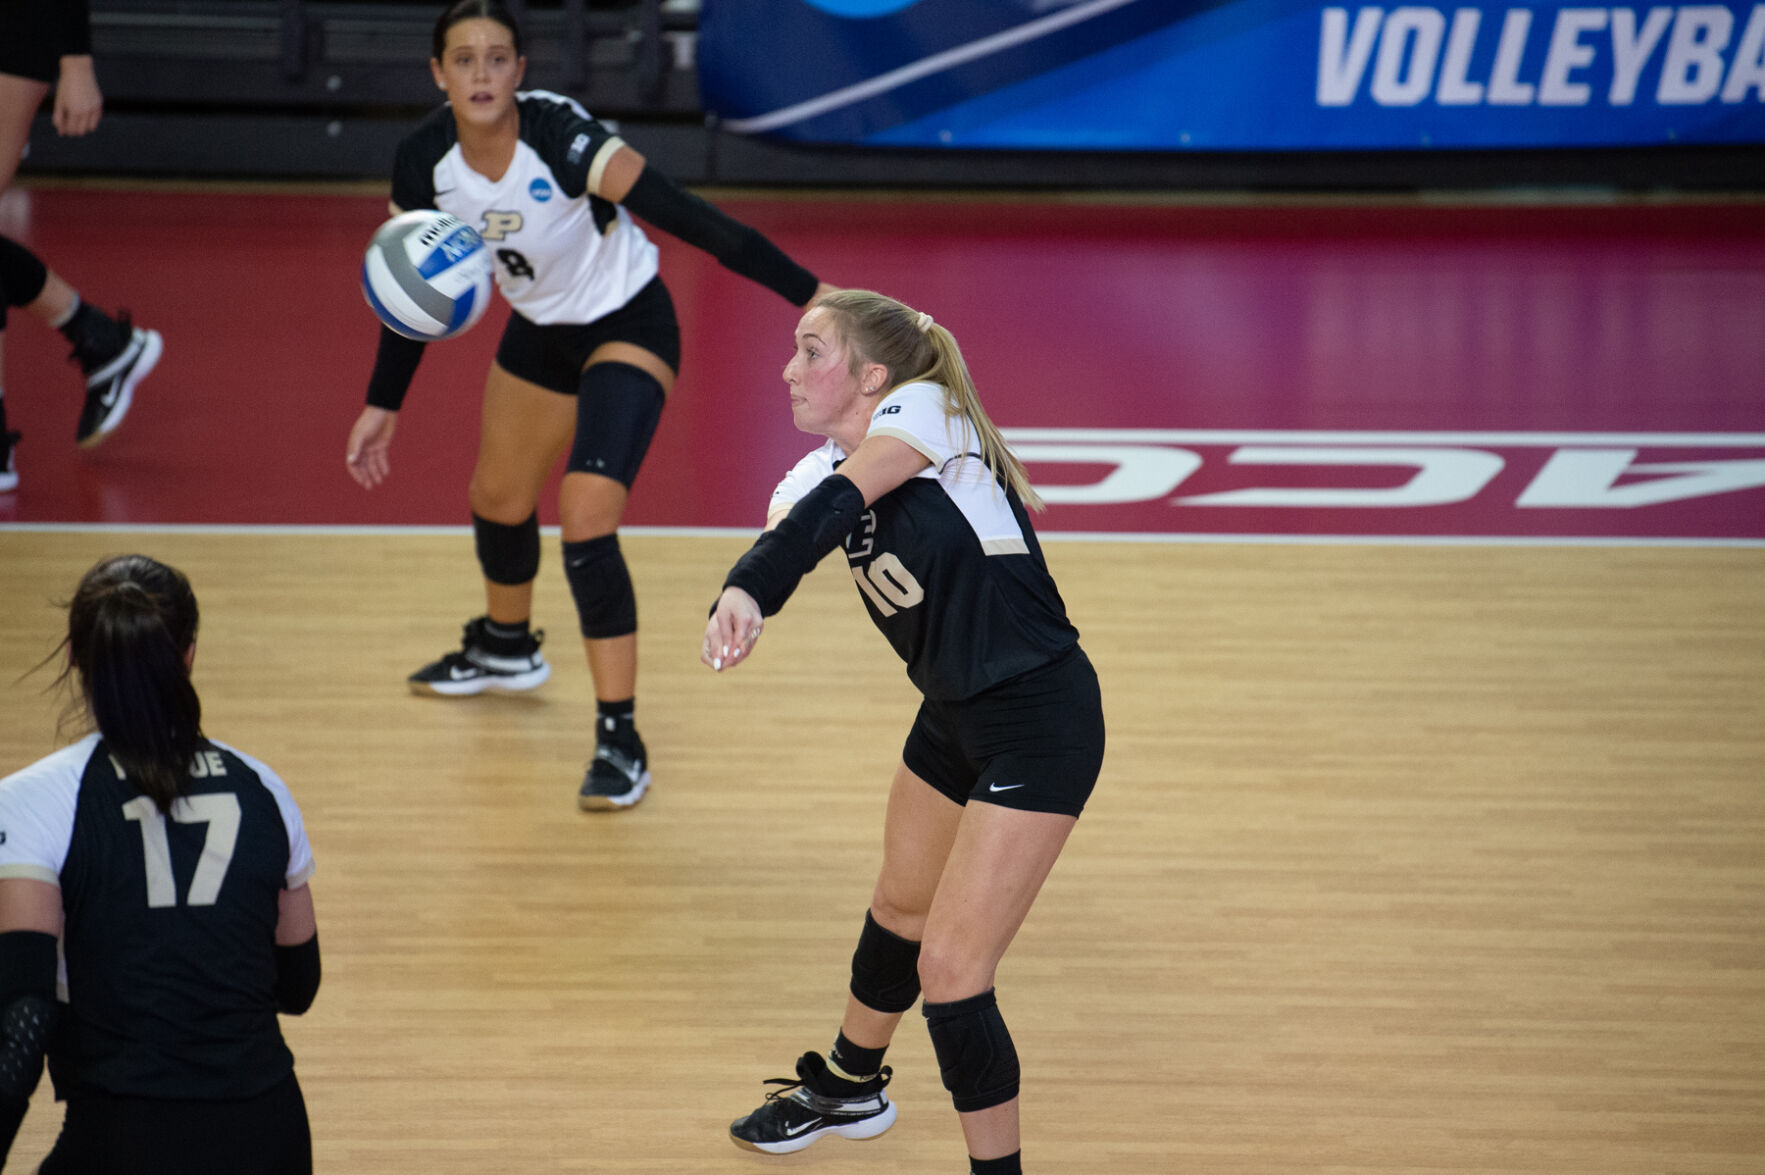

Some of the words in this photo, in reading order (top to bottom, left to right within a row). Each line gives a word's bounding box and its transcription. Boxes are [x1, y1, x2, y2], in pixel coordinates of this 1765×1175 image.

[481, 209, 523, 241] P
[496, 248, 534, 281] 8
[122, 792, 242, 908] 17
